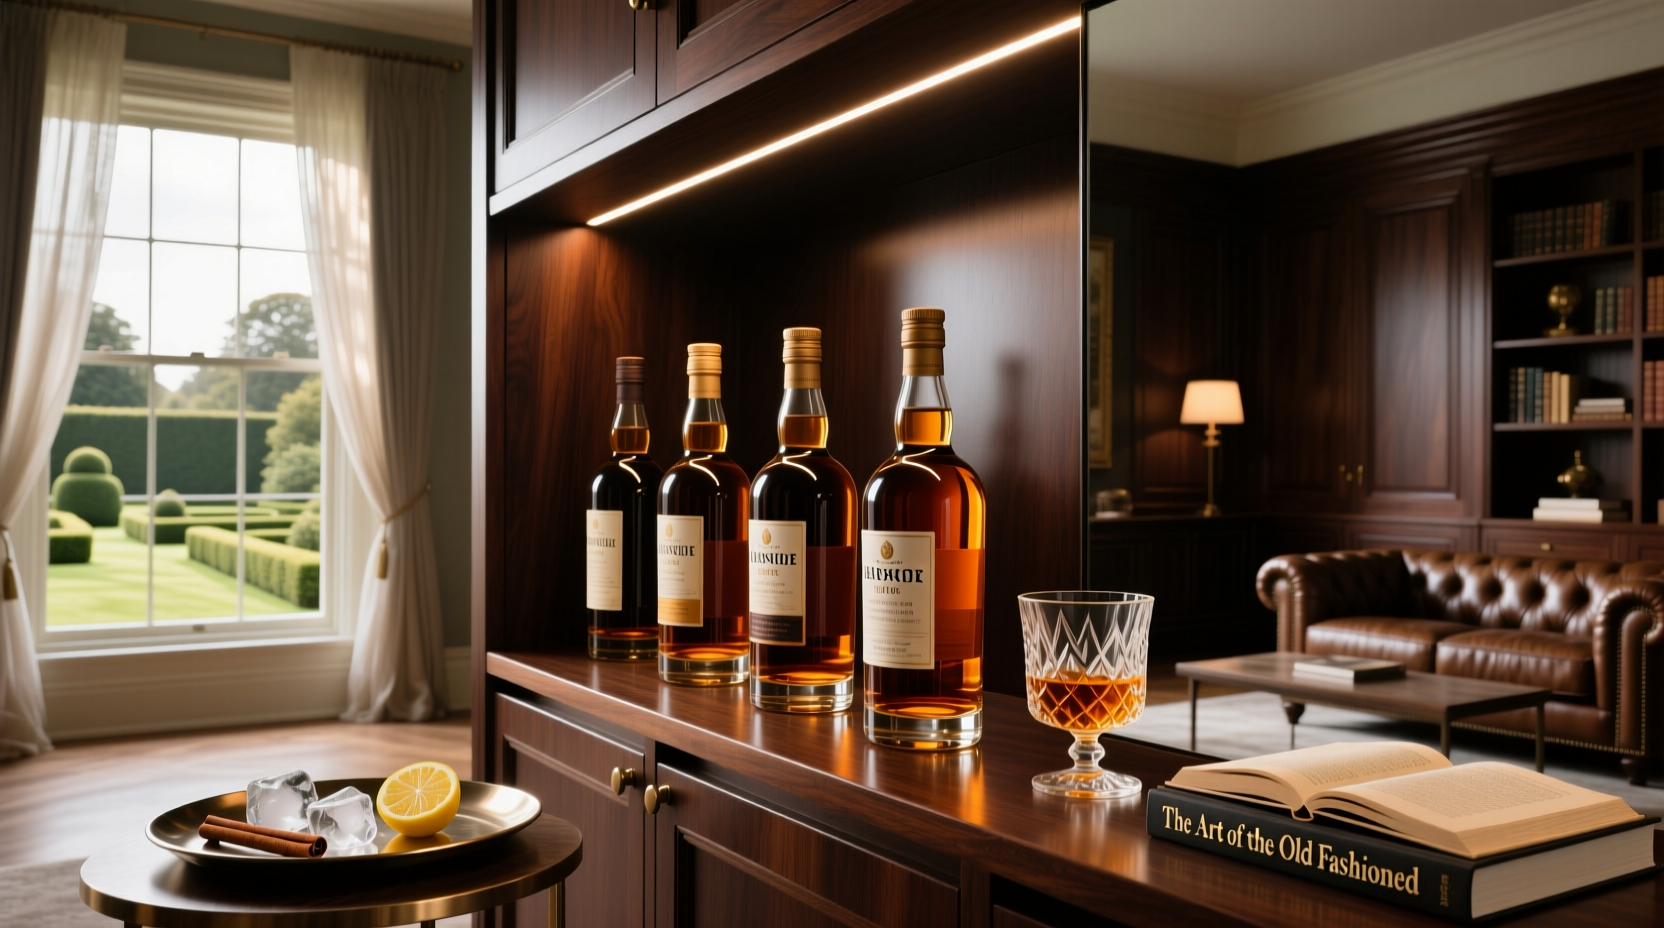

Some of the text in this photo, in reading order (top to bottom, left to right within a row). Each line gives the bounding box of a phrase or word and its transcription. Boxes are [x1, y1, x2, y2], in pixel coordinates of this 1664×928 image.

[1162, 805, 1192, 834] The
[1195, 813, 1224, 843] Art
[1227, 823, 1246, 848] of
[1247, 827, 1275, 857] the
[1279, 834, 1313, 866] Old
[1317, 843, 1420, 896] Fashioned
